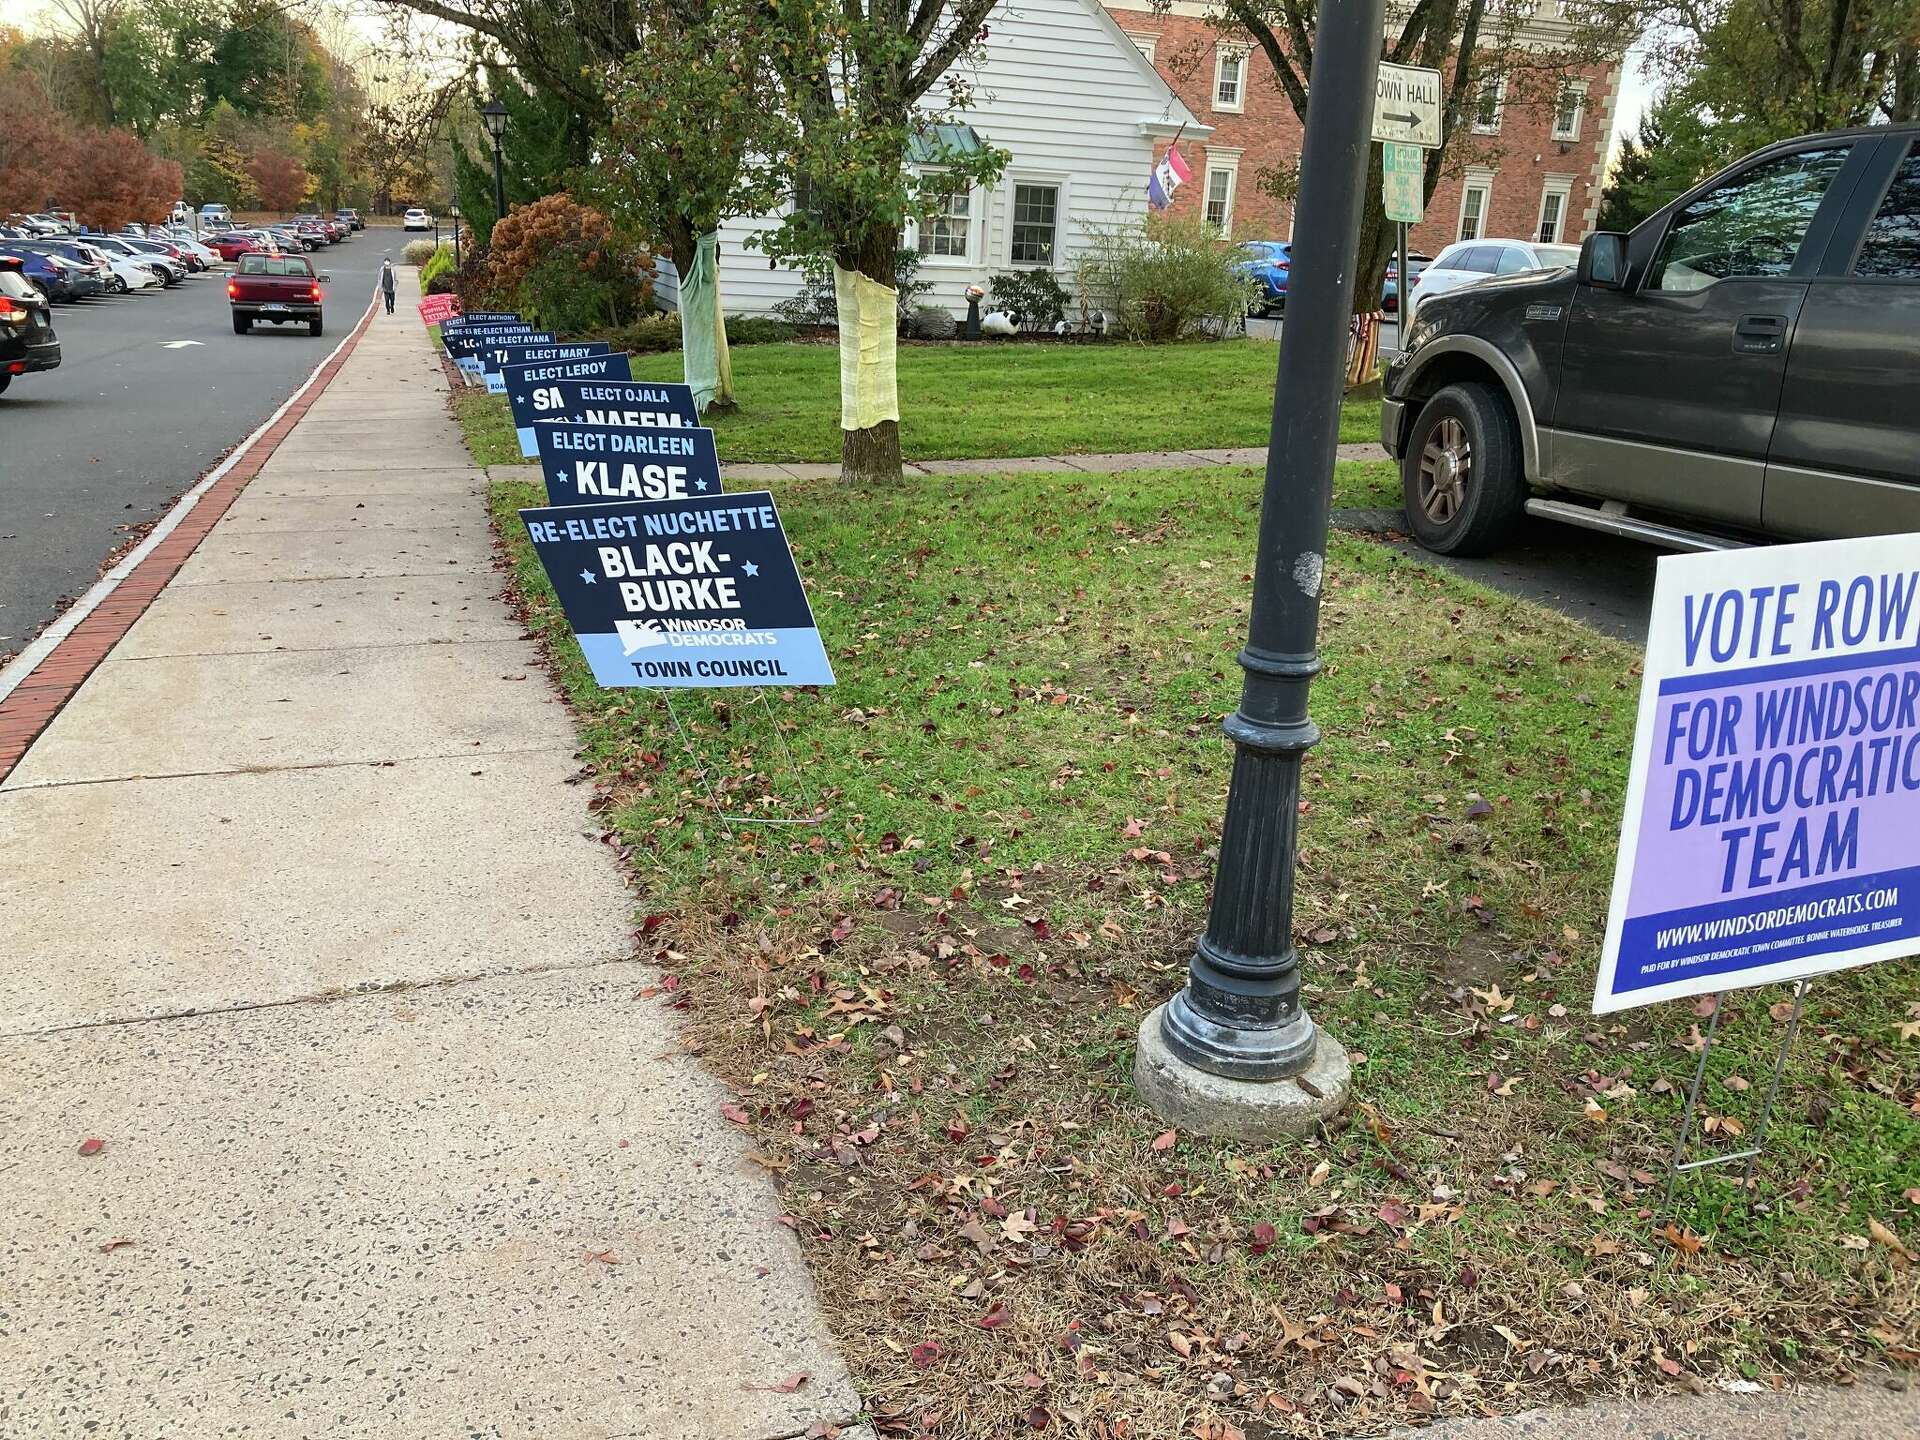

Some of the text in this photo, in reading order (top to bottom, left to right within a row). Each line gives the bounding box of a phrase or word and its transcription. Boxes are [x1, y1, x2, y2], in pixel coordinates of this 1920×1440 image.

[1376, 79, 1435, 105] OWN HALL
[446, 318, 462, 326] ELECT
[473, 326, 531, 335] RE-ELECT NATHAN
[485, 335, 550, 344] RE-ELECT AYANA
[525, 348, 590, 360] ELECT MARY
[524, 361, 607, 381] ELECT LEROY
[580, 387, 670, 403] ELECT OJALA
[552, 431, 694, 456] ELECT DARLEEN
[575, 460, 689, 500] KLASE
[528, 505, 776, 543] RE-ELECT NUCHETTE
[598, 540, 731, 578] BLACK-
[618, 577, 741, 612] BURKE
[660, 617, 747, 632] WINDSOR
[1684, 571, 1920, 667] VOTE ROW
[667, 632, 777, 647] DEMOCRATS
[631, 659, 788, 678] TOWN COUNCIL
[1664, 671, 1920, 765] FOR WINDSOR
[1669, 732, 1920, 831] DEMOCRATIC
[1721, 807, 1860, 893] TEAM
[1656, 887, 1898, 950] WWW.WINDSORDEMOCRATS.COM
[1641, 963, 1656, 974] PAID
[1657, 960, 1669, 971] FOR
[1671, 959, 1679, 969] BY
[1680, 953, 1710, 966] WINDSOR
[1711, 946, 1751, 961] DEMOCRATIC
[1752, 941, 1770, 953] TOWN
[1806, 930, 1830, 943] BONNIE
[1871, 918, 1903, 931] TREASURER
